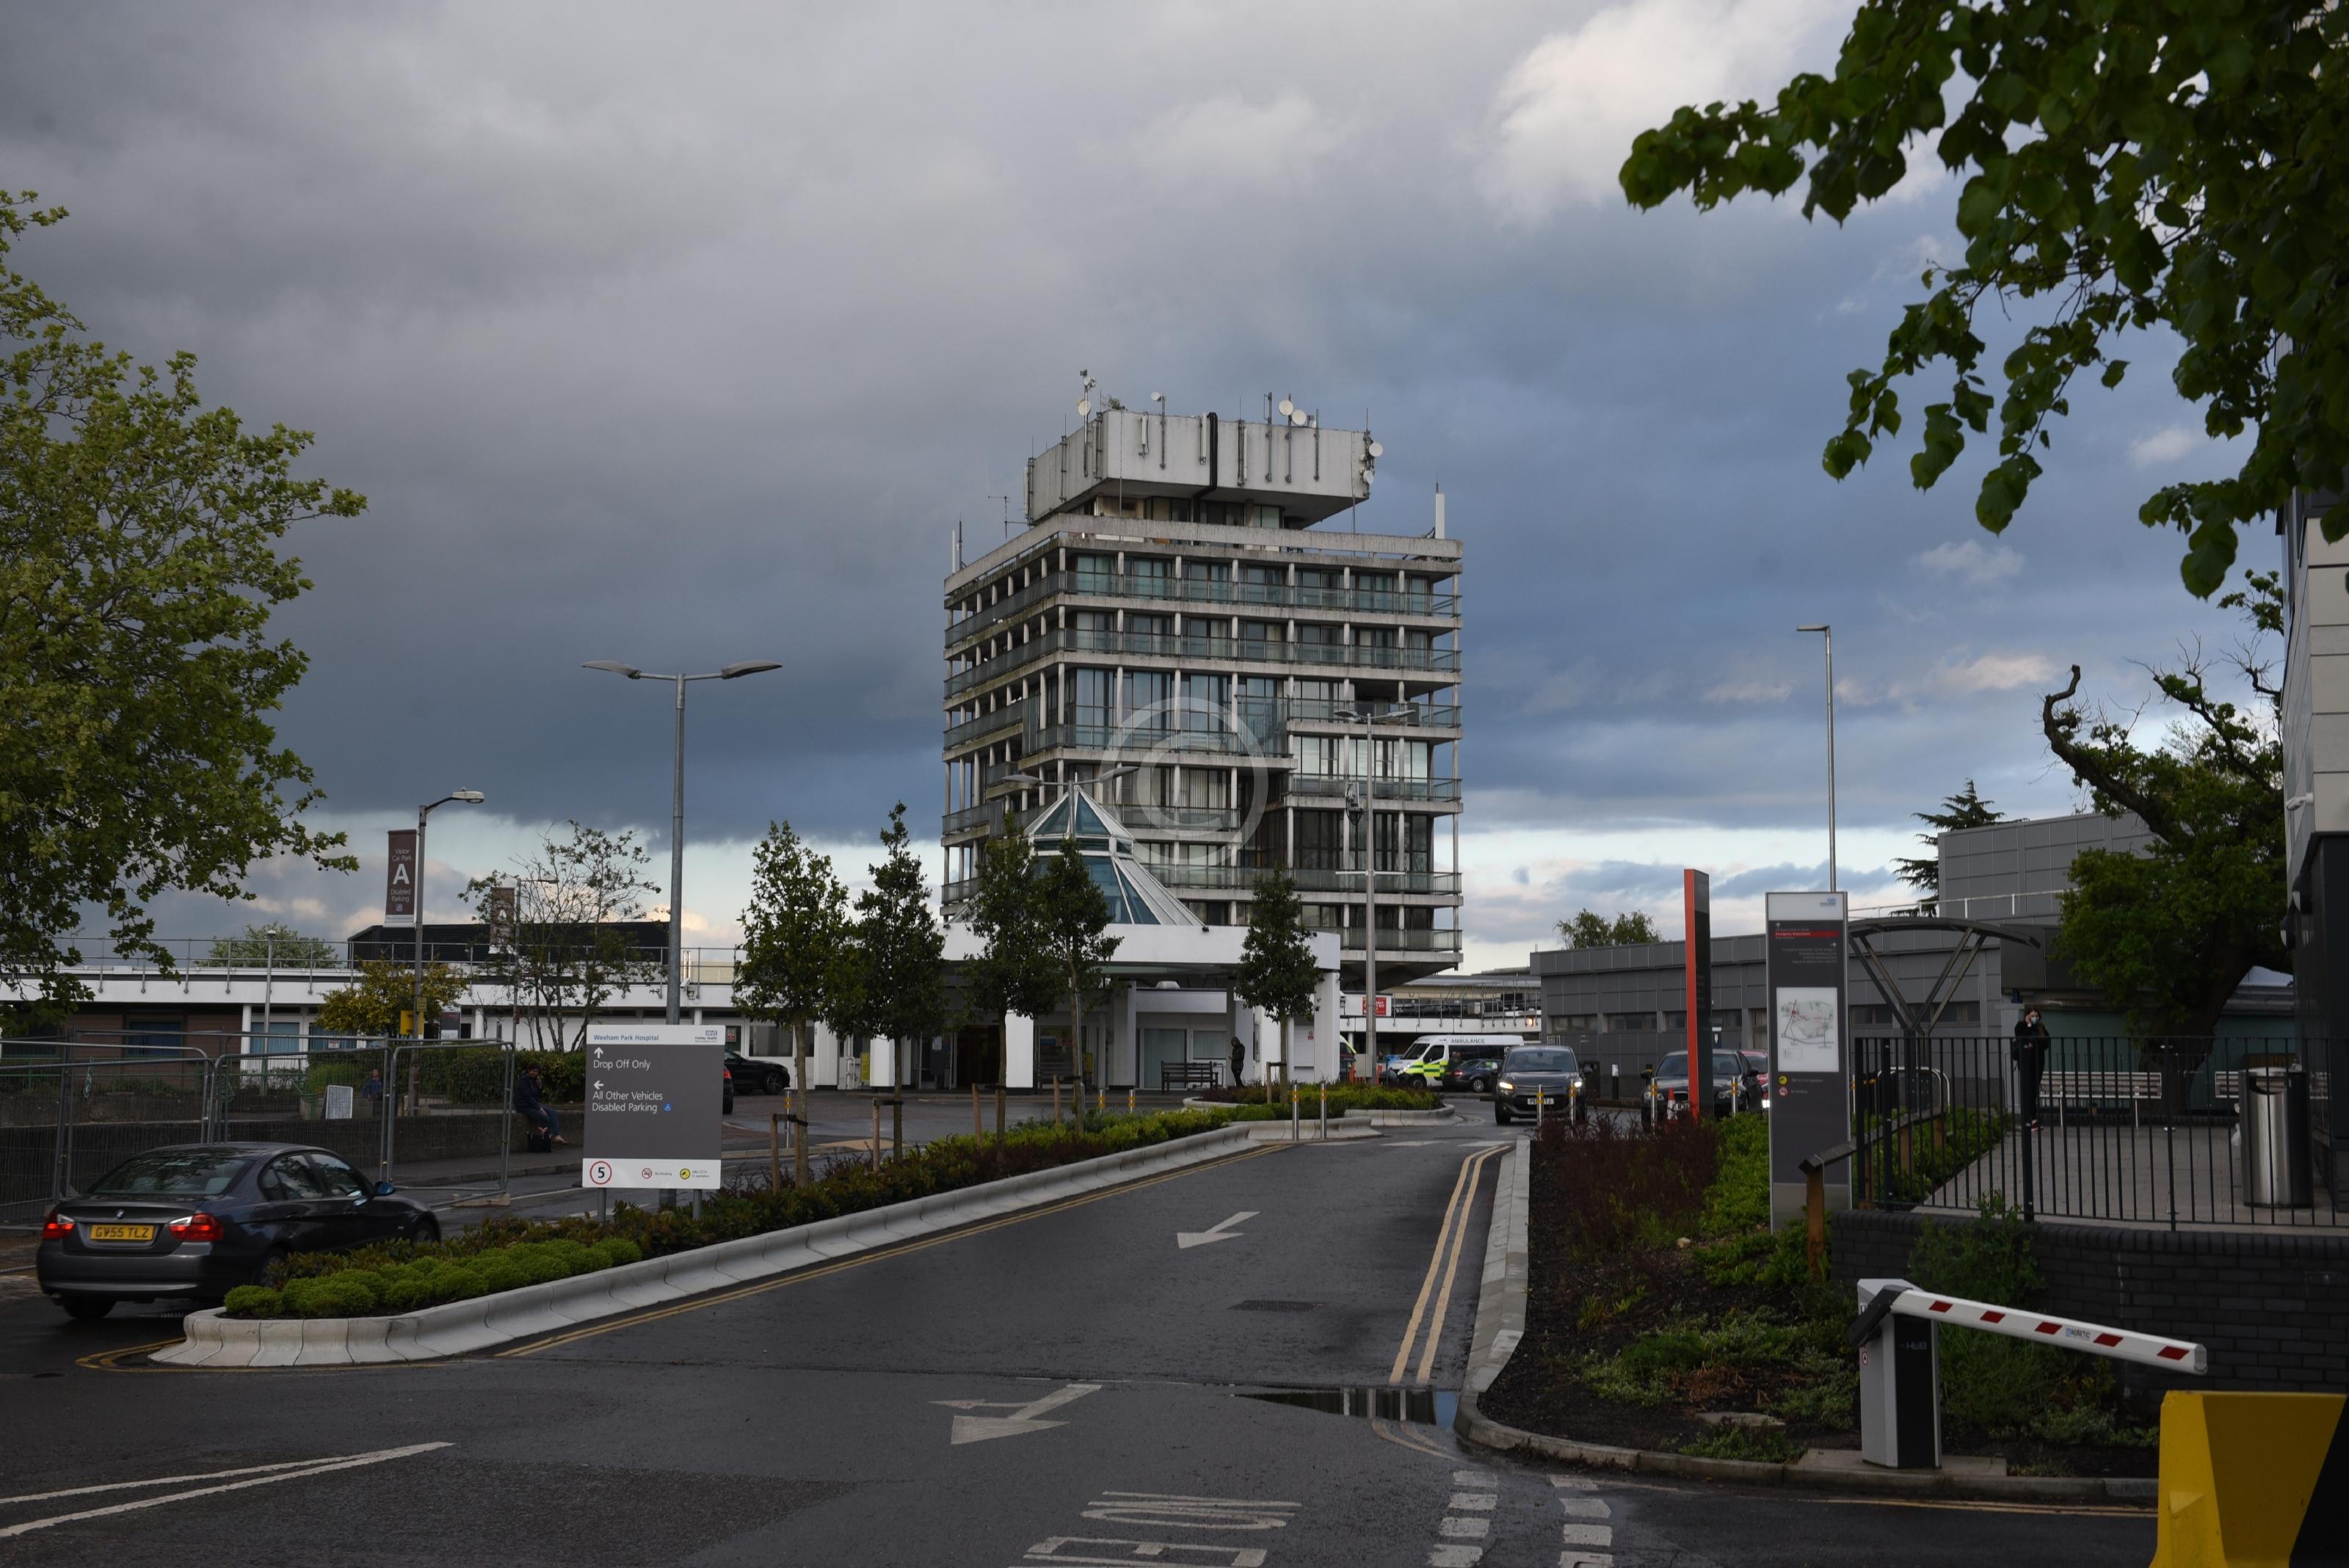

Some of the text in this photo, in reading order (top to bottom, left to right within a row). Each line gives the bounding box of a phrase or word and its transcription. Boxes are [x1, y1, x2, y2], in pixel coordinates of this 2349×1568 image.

[393, 863, 410, 885] A
[593, 1059, 651, 1071] Drop Off Only
[592, 1091, 664, 1100] All Other Vehicles
[592, 1103, 658, 1114] Disabled Parking
[598, 1166, 605, 1178] 5
